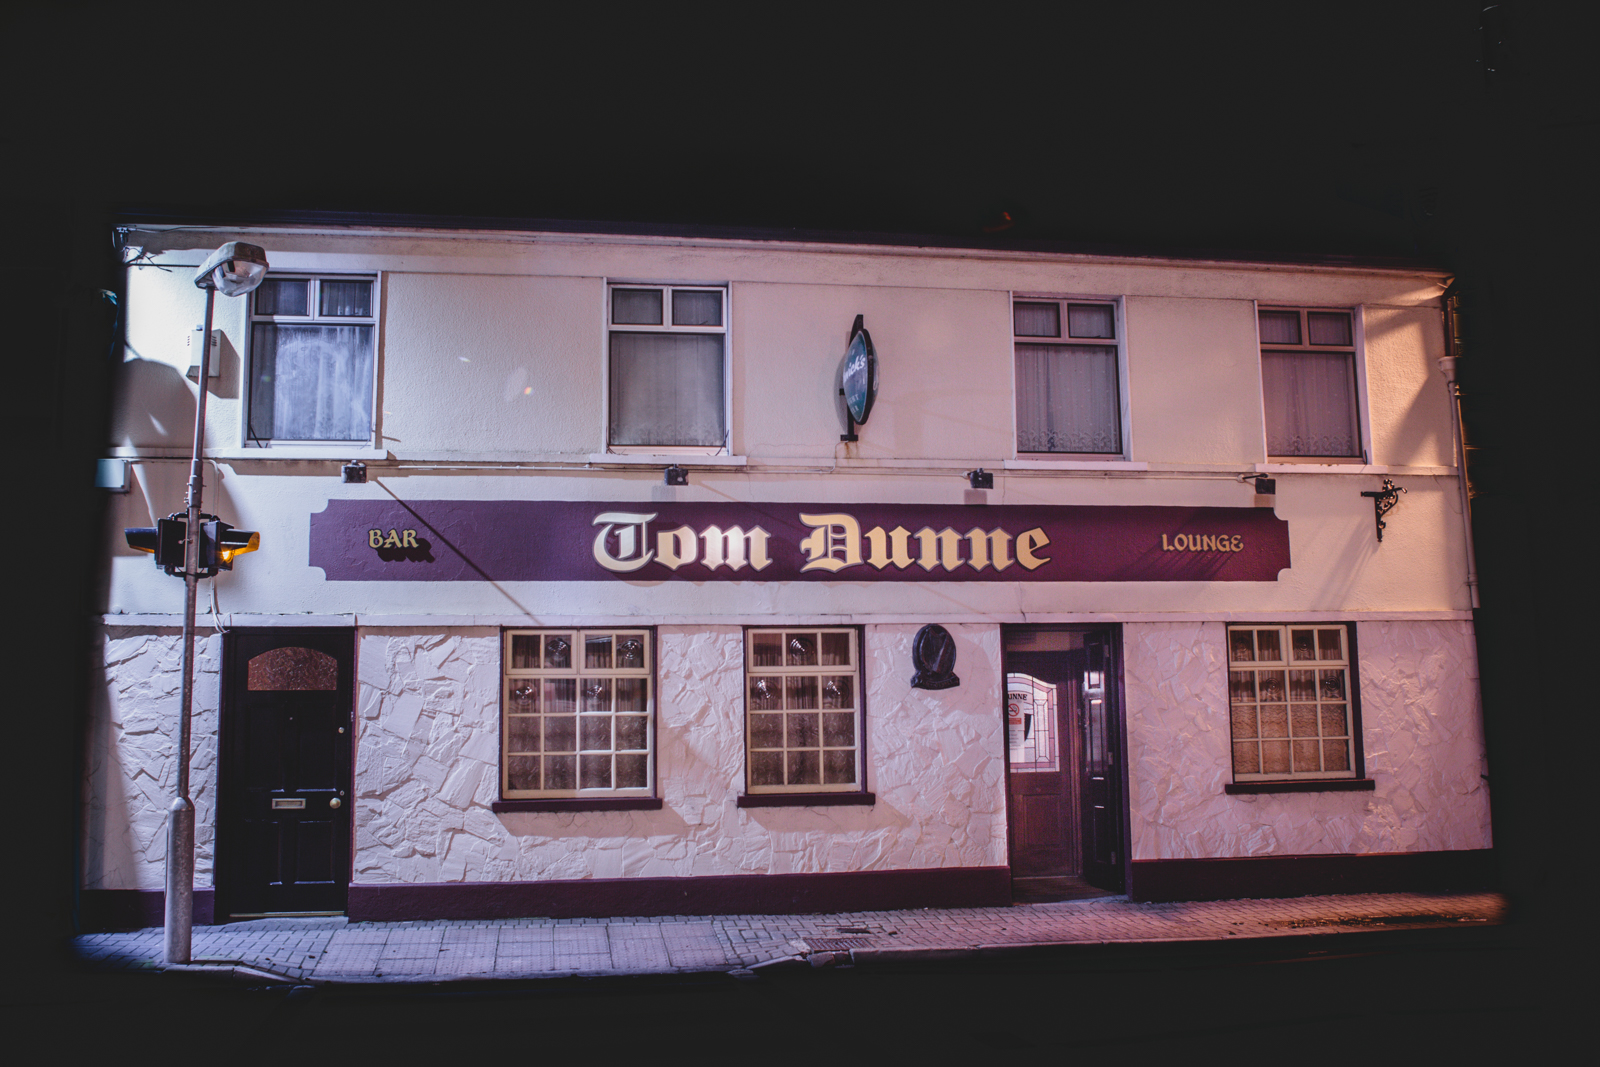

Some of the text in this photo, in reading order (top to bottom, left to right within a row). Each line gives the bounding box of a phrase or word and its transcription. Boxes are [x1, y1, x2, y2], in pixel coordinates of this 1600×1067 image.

[368, 529, 419, 548] BAR
[592, 511, 1052, 574] Tom Dunne
[1161, 533, 1244, 552] LOUNGE
